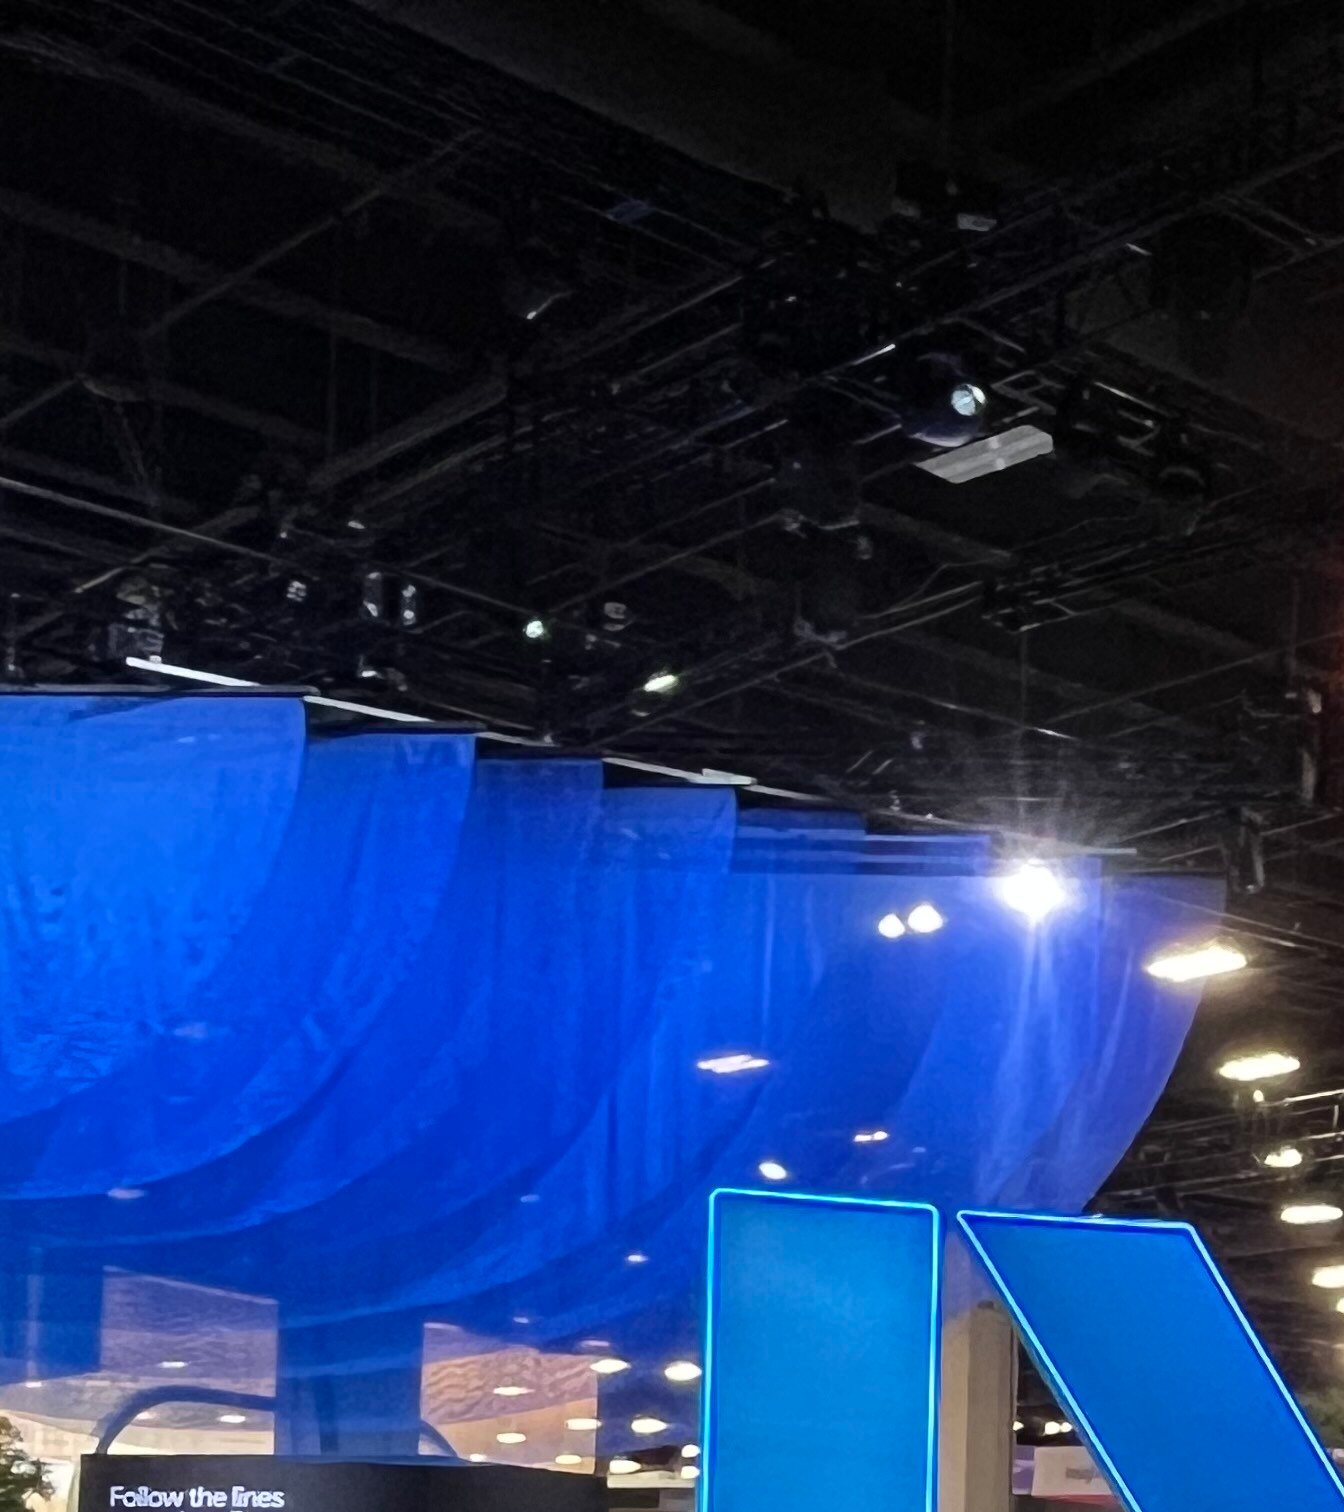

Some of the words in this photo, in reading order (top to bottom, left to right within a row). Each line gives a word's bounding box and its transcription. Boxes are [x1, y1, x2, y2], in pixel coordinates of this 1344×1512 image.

[109, 1485, 185, 1508] Follow
[189, 1485, 228, 1508] the
[231, 1485, 285, 1508] lines
